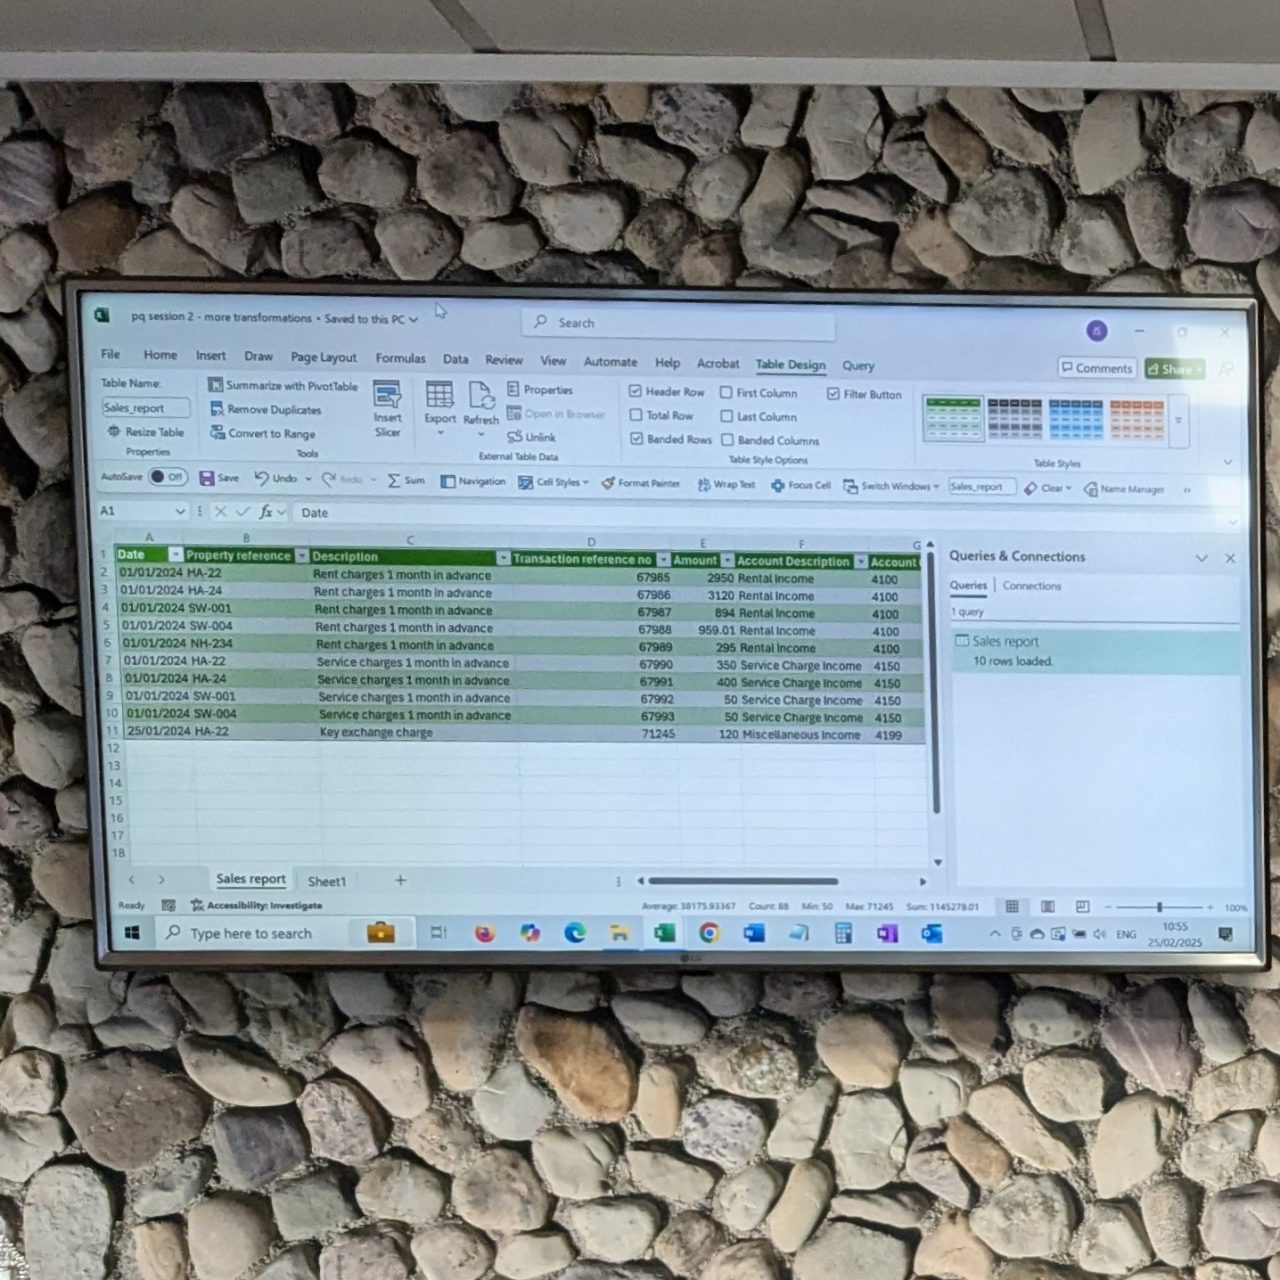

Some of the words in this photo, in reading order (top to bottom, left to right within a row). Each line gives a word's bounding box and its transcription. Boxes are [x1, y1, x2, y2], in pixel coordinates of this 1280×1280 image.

[132, 312, 145, 322] pq
[149, 312, 185, 322] session
[188, 312, 194, 321] 2
[204, 313, 230, 323] more
[233, 312, 312, 324] transformations
[324, 313, 354, 324] Saved
[357, 314, 368, 324] to
[371, 313, 389, 324] this
[392, 314, 405, 324] PC
[559, 318, 595, 328] Search
[101, 349, 120, 360] File
[144, 350, 178, 361] Home
[197, 351, 226, 361] Insert
[245, 352, 273, 362] Draw
[291, 352, 318, 365] Page
[320, 352, 357, 364] Layout
[376, 353, 426, 364] Formulas
[443, 354, 469, 364] Data
[486, 355, 523, 365] Review
[541, 355, 567, 366] View
[584, 356, 638, 368] Automate
[656, 357, 681, 370] Help
[698, 358, 740, 369] Acrobat
[756, 359, 784, 370] Table
[788, 359, 826, 373] Design
[843, 360, 875, 373] Query
[1077, 362, 1133, 374] Comments
[1162, 364, 1192, 375] Share
[101, 378, 127, 388] Table
[129, 378, 161, 389] Name:
[226, 380, 282, 391] Summarize
[284, 380, 306, 391] with
[308, 381, 358, 392] PivotTable
[524, 385, 573, 397] Properties
[646, 387, 678, 398] Header
[680, 388, 705, 398] Row
[737, 388, 756, 398] First
[759, 388, 798, 399] Column
[844, 389, 867, 399] Filter
[870, 390, 902, 401] Button
[103, 402, 164, 415] Sales_report
[228, 404, 269, 416] Remove
[272, 405, 321, 417] Duplicates
[374, 412, 402, 423] Insert
[425, 413, 456, 425] Export
[463, 415, 499, 425] Refresh
[647, 411, 670, 421] Total
[672, 411, 693, 421] Row
[738, 412, 756, 422] Last
[759, 412, 797, 423] Column
[229, 428, 268, 439] Convert
[271, 429, 280, 439] to
[283, 429, 316, 442] Range
[375, 427, 401, 438] Slicer
[526, 432, 556, 443] Unlink
[648, 435, 681, 445] Banded
[683, 435, 712, 445] Rows
[738, 436, 774, 446] Banded
[778, 436, 820, 447] Columns
[101, 506, 114, 516] A1
[302, 508, 328, 519] Date
[118, 550, 145, 560] Date
[186, 550, 234, 563] Property
[237, 551, 291, 562] reference
[312, 552, 378, 563] Description
[514, 554, 580, 565] Transaction
[581, 554, 636, 566] reference
[637, 556, 652, 566] no
[674, 555, 717, 566] Amount
[738, 557, 783, 568] Account
[786, 557, 850, 568] Description
[871, 557, 917, 568] Account
[950, 550, 995, 563] Queries
[999, 551, 1009, 562] &
[1011, 551, 1086, 563] Connections
[120, 568, 183, 578] 01/01/2024
[187, 568, 221, 578] HA-22
[313, 570, 338, 580] Rent
[341, 570, 384, 581] charges
[388, 570, 393, 580] 1
[396, 571, 431, 580] month
[433, 571, 443, 580] in
[446, 571, 492, 581] advance
[637, 573, 670, 583] 67985
[707, 573, 734, 583] 2950
[738, 574, 772, 584] Rental
[774, 574, 814, 584] Income
[872, 575, 898, 584] 4100
[950, 580, 988, 591] Queries
[1003, 581, 1062, 592] Connections
[952, 607, 956, 616] 1
[958, 608, 984, 619] query
[973, 636, 1001, 647] Sales
[1004, 636, 1039, 648] report
[124, 656, 187, 666] 01/01/2024
[191, 656, 226, 666] HA-22
[317, 658, 357, 667] Service
[360, 658, 402, 670] charges
[406, 659, 412, 668] 1
[414, 659, 450, 668] month
[452, 659, 462, 669] in
[464, 659, 509, 669] advance
[640, 660, 673, 670] 67990
[717, 661, 737, 670] 350
[741, 661, 781, 671] Service
[783, 661, 820, 673] Charge
[822, 661, 862, 671] Income
[874, 662, 900, 671] 4150
[974, 656, 986, 666] 10
[989, 657, 1013, 667] rows
[1016, 657, 1053, 667] loaded.
[127, 726, 191, 736] 25/01/2024
[195, 727, 229, 736] HA-22
[320, 728, 339, 740] Key
[341, 728, 393, 739] exchange
[396, 729, 433, 739] charge
[642, 730, 675, 739] 71245
[719, 730, 738, 739] 120
[743, 730, 819, 740] Miscellaneous
[822, 730, 861, 740] Income
[876, 731, 903, 740] 4199
[216, 873, 247, 884] Sales
[250, 873, 286, 886] report
[308, 876, 346, 888] Sheet1
[1163, 922, 1188, 932] 10:55
[191, 928, 221, 941] Type
[225, 929, 252, 939] here
[256, 929, 268, 940] to
[271, 929, 312, 940] search
[1117, 930, 1137, 940] ENG
[1148, 938, 1202, 948] 25/02/2025
